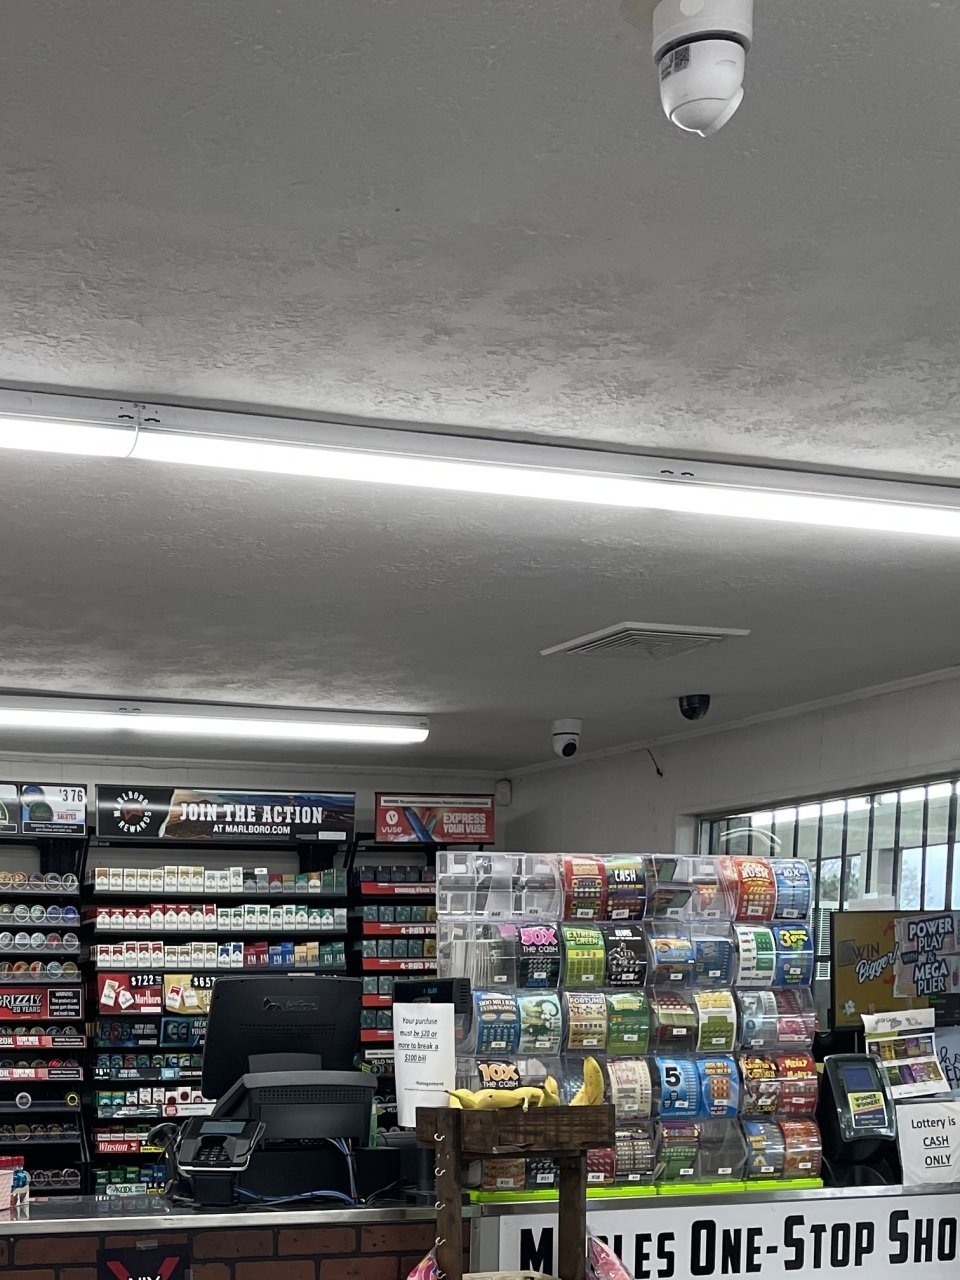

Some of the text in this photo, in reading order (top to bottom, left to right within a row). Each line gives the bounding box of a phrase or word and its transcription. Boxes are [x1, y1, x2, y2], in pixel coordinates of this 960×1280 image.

[113, 790, 149, 817] MARLBORO
[179, 803, 323, 824] JOIN THE ACTION
[443, 813, 486, 824] EXPRESS
[117, 811, 153, 833] REWARDS
[443, 823, 486, 834] YOUR VUSE
[212, 824, 290, 835] AT MARLBORO.COM
[614, 869, 637, 882] CASH
[909, 917, 953, 939] POWER
[520, 927, 558, 946] 50X
[575, 937, 599, 946] GREEN
[919, 933, 945, 952] PLAY
[852, 943, 880, 959] WIN
[927, 951, 936, 962] &
[855, 942, 900, 984] Bigger!
[914, 962, 948, 982] MEGA
[917, 977, 946, 996] PLIER
[135, 990, 162, 1005] Marlboro
[402, 1017, 438, 1026] Your purchase
[420, 1030, 430, 1038] $20
[417, 1042, 433, 1050] break
[404, 1053, 427, 1062] $100 bill
[479, 1063, 520, 1082] 10X
[911, 1116, 957, 1130] Lottery is
[98, 1142, 128, 1152] Winston
[923, 1136, 949, 1147] CASH
[924, 1154, 952, 1166] ONLY
